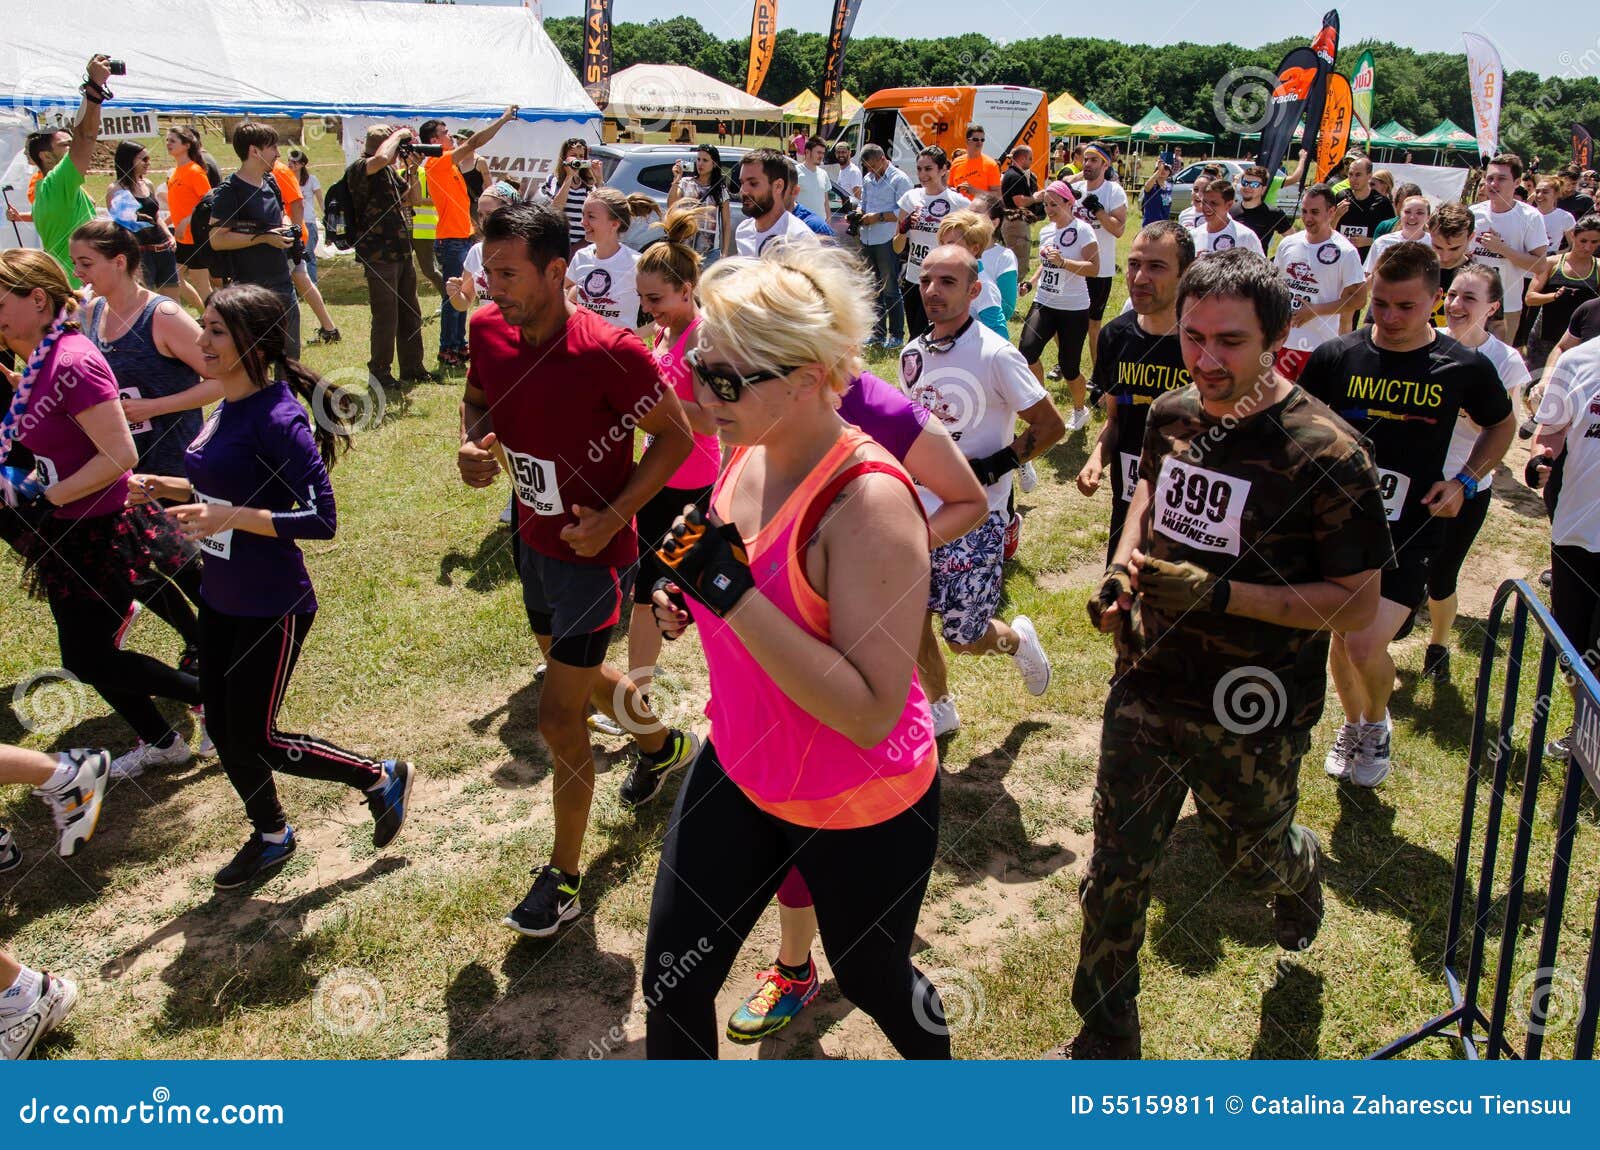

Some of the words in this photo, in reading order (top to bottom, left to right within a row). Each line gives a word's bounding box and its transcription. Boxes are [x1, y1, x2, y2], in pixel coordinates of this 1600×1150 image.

[1271, 92, 1299, 105] radio
[481, 154, 552, 172] MATE
[1043, 270, 1060, 285] 251
[1347, 375, 1443, 408] INVICTUS
[1165, 466, 1232, 524] 399
[1163, 508, 1209, 530] ULTIMATE
[1161, 514, 1229, 549] MUDNESS
[200, 537, 225, 553] NESS
